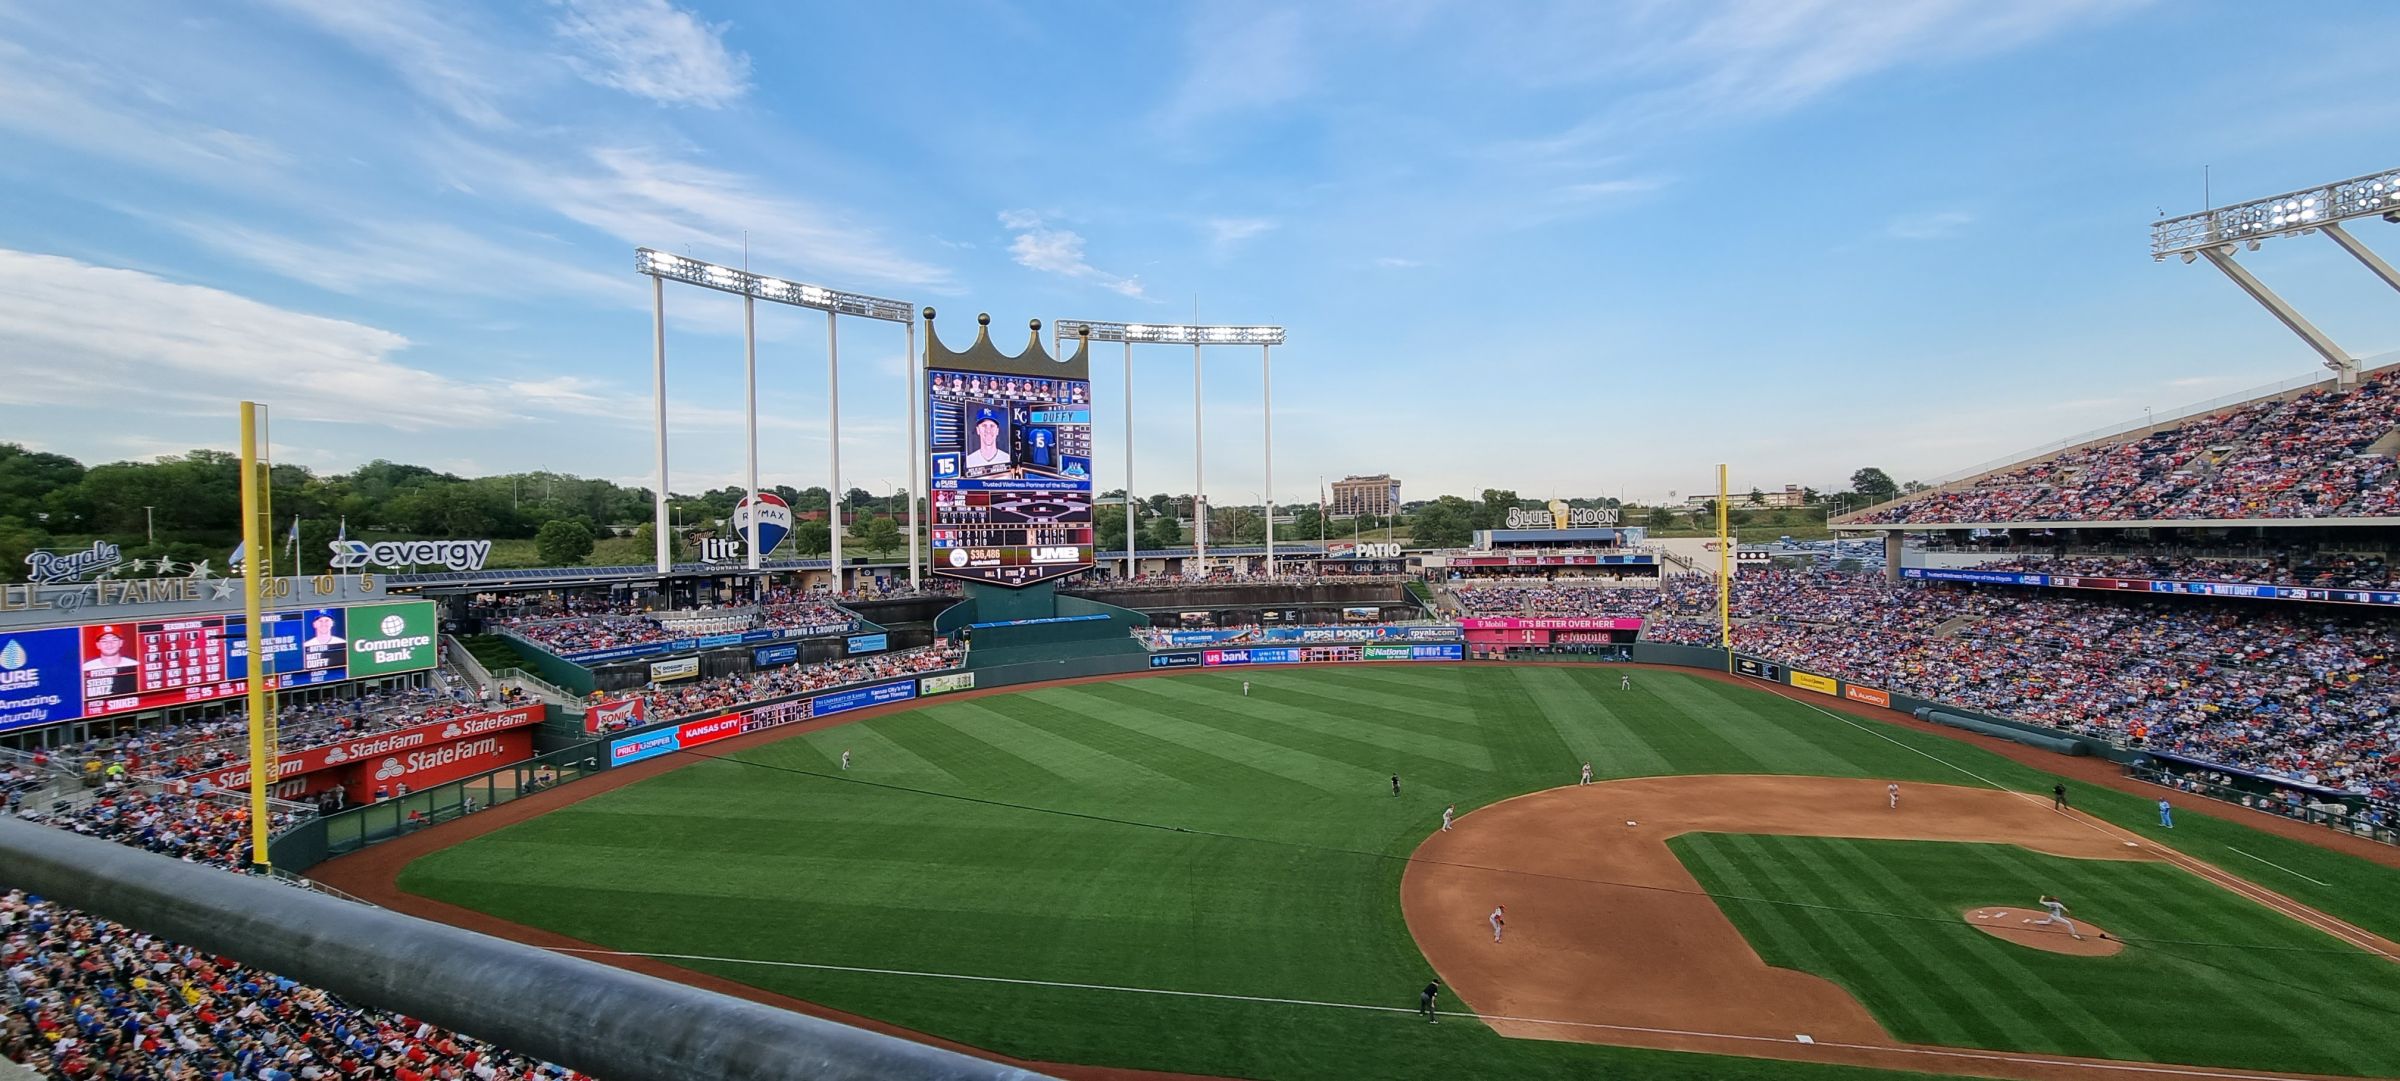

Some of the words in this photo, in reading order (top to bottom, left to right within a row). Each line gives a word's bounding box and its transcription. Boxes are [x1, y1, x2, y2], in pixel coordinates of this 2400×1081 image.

[1013, 407, 1028, 424] KC
[1042, 411, 1074, 422] DUFFY
[937, 458, 955, 475] 15
[742, 509, 784, 521] R/MAX
[1506, 506, 1550, 529] BLUE
[1571, 507, 1618, 525] MOON
[373, 541, 490, 570] evergy
[701, 538, 740, 565] Lite
[970, 549, 1000, 560] $36,486
[1030, 546, 1080, 559] UMB
[1356, 544, 1400, 558] PATIO
[25, 540, 121, 584] Royals
[1354, 563, 1398, 572] CHOPER
[1020, 567, 1026, 578] 2
[260, 576, 291, 598] 20
[312, 574, 336, 595] 10
[360, 572, 375, 592] 5
[2214, 584, 2234, 595] MATT
[2234, 586, 2258, 596] DUFFY
[59, 585, 94, 614] of
[96, 577, 202, 606] FAME
[2289, 589, 2307, 599] .259
[2359, 593, 2369, 602] 10
[1519, 620, 1534, 628] IT'S
[1536, 620, 1567, 628] BETTER
[1568, 620, 1591, 628] OVER
[1592, 620, 1615, 628] HERE
[784, 627, 808, 638] BROWN
[809, 626, 814, 635] &
[816, 624, 848, 635] CROUPPEN
[1304, 630, 1334, 638] PEPSI
[1336, 629, 1374, 638] PORCH
[1522, 630, 1536, 644] T
[1570, 632, 1609, 642] Mobile
[354, 635, 430, 653] Commerce
[375, 646, 411, 664] Bank
[1208, 654, 1220, 662] us
[1222, 651, 1248, 662] bank
[1376, 648, 1410, 656] National
[306, 658, 329, 668] DUFFY
[1187, 656, 1198, 664] City
[888, 686, 900, 695] City's
[1858, 692, 1885, 704] Audacy
[601, 710, 630, 724] SONIC
[686, 724, 719, 738] KANSAS
[720, 718, 738, 732] CITY
[617, 744, 637, 756] PRICE
[640, 737, 671, 750] CHOPPER
[218, 759, 304, 790] StatFarm
